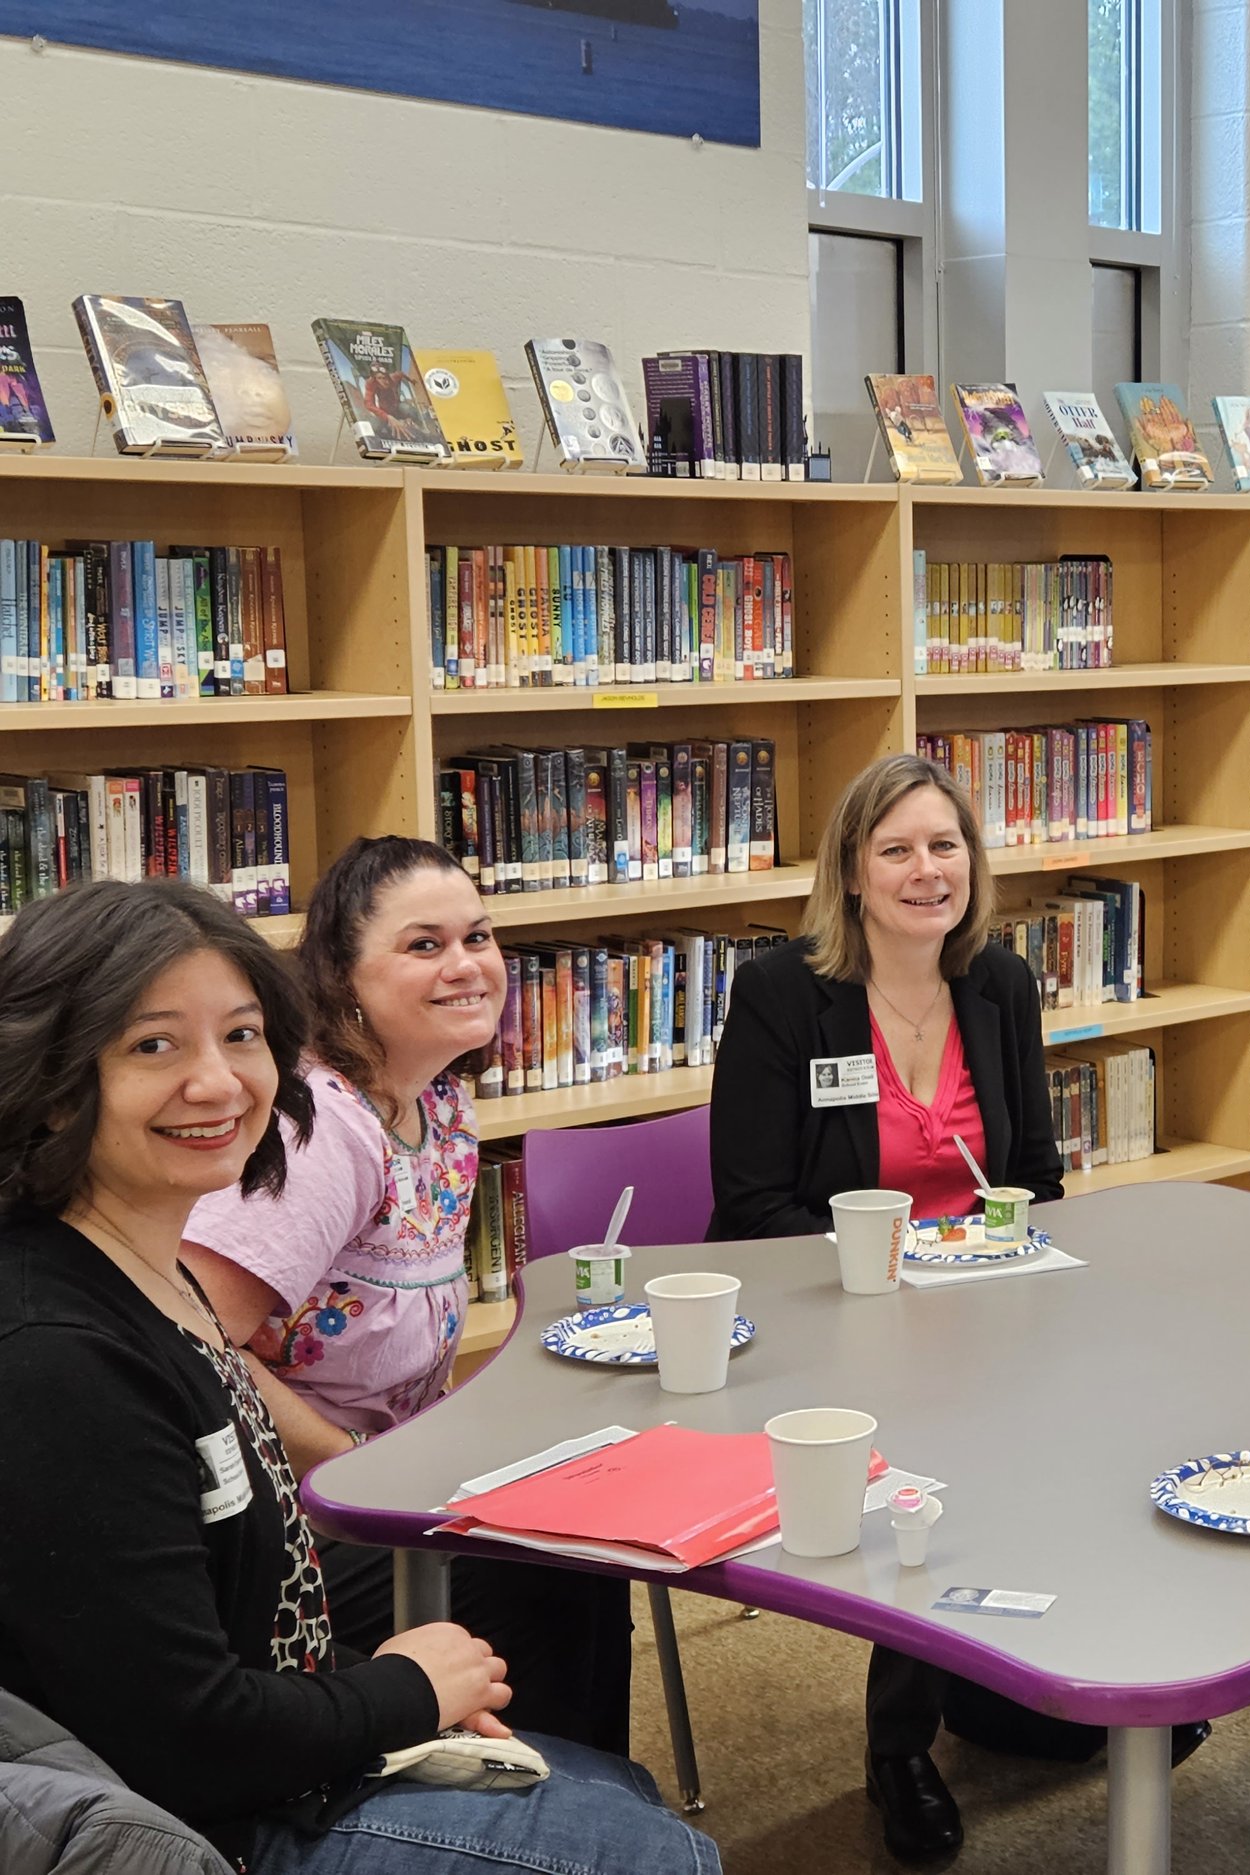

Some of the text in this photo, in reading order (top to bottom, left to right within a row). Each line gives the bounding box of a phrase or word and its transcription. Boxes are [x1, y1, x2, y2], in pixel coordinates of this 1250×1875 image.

[350, 344, 394, 357] MORALES
[356, 335, 384, 346] MILES
[1058, 405, 1098, 419] OTTER
[1073, 417, 1096, 430] Half
[1, 598, 17, 639] Hatchet
[517, 588, 528, 640] GHOST
[529, 588, 538, 640] GHOST
[540, 587, 549, 637] PATINA
[552, 588, 561, 628] SUNNY
[601, 568, 610, 632] MILES MORALES
[744, 595, 752, 624] GHOST
[159, 607, 167, 634] JUMP
[175, 607, 186, 664] JUMP SKY
[1136, 752, 1145, 795] ECHO
[753, 798, 763, 832] HADES
[38, 842, 48, 862] dead
[168, 829, 177, 878] WILDFIR
